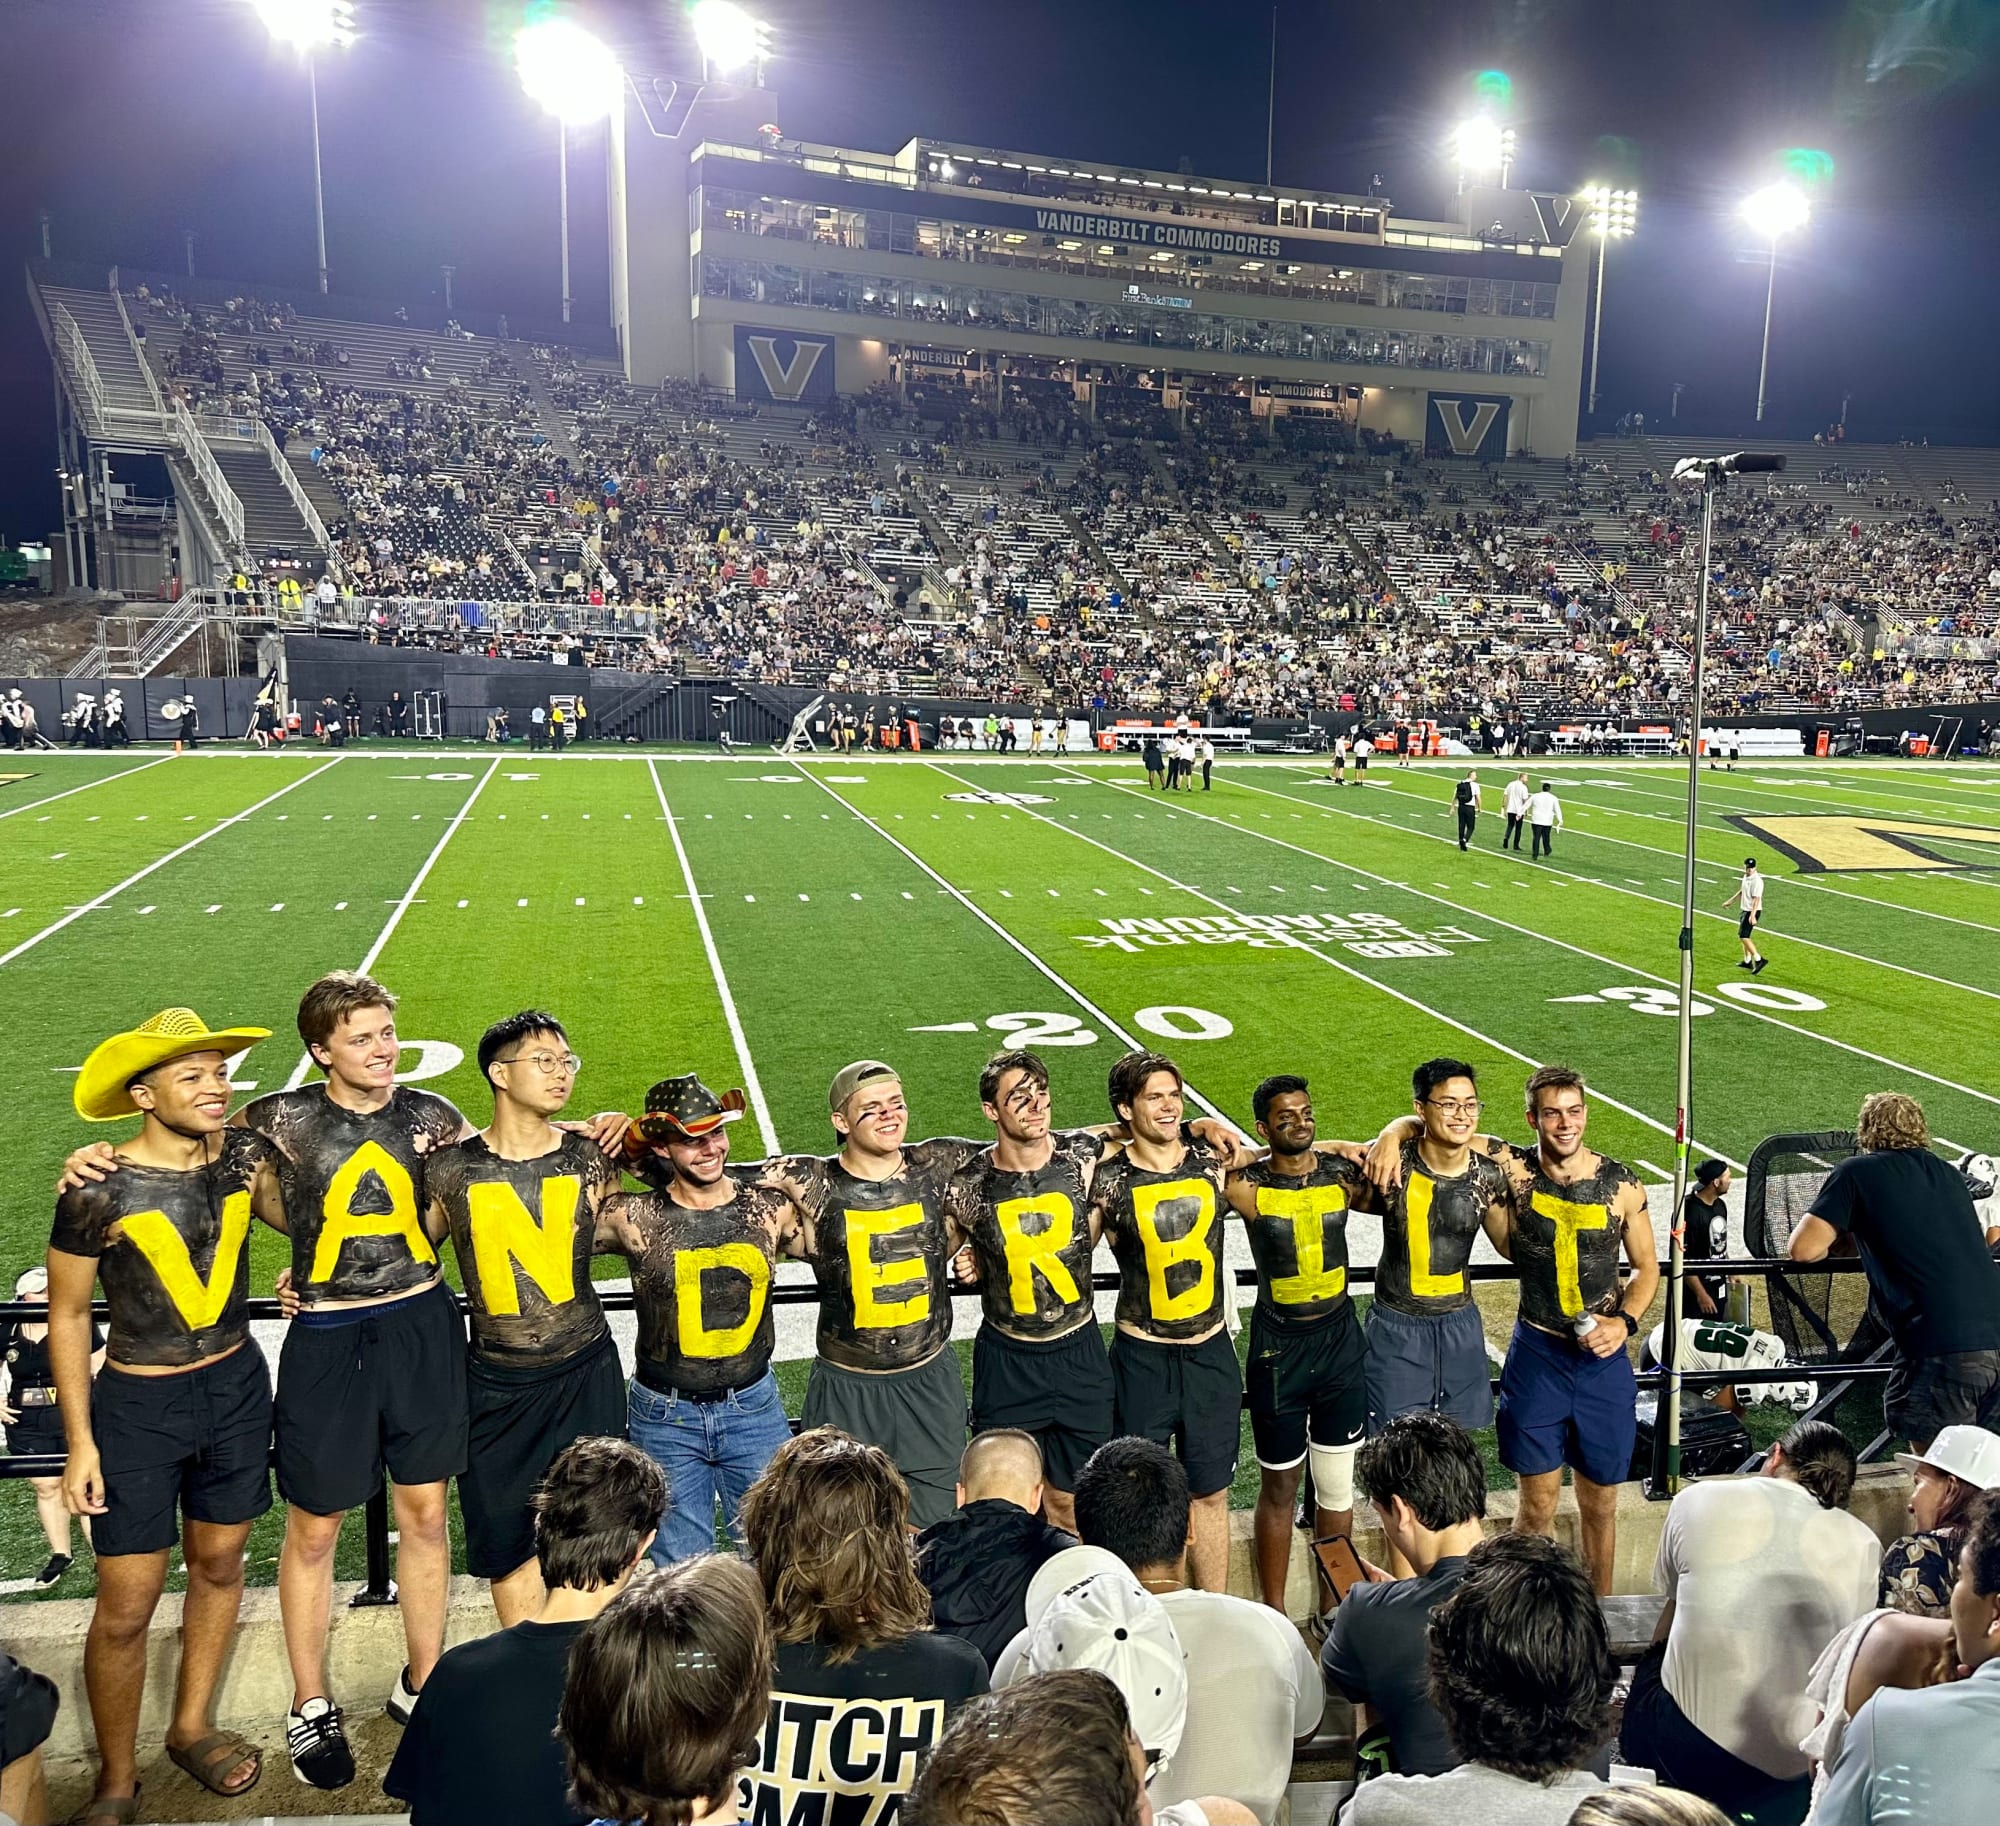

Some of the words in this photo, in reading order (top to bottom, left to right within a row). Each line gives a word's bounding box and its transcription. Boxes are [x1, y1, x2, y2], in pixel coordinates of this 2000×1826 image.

[1036, 210, 1150, 241] VANDERBILT
[1154, 226, 1281, 257] COMMODORES
[747, 335, 828, 400] V
[899, 349, 969, 366] ANDERBILT
[1260, 383, 1334, 399] MODORES
[1432, 399, 1500, 455] V
[1070, 925, 1492, 953] FirstBank
[1098, 912, 1401, 934] STADIUM
[117, 1190, 253, 1331] V
[309, 1140, 438, 1283] A
[468, 1175, 581, 1315] N
[674, 1243, 771, 1358] D
[844, 1203, 930, 1329] E
[996, 1191, 1080, 1315] R
[1132, 1178, 1216, 1321] B
[1256, 1184, 1346, 1304] I
[1406, 1171, 1465, 1297] L
[1531, 1191, 1609, 1317] T
[748, 1695, 941, 1785] ITCH
